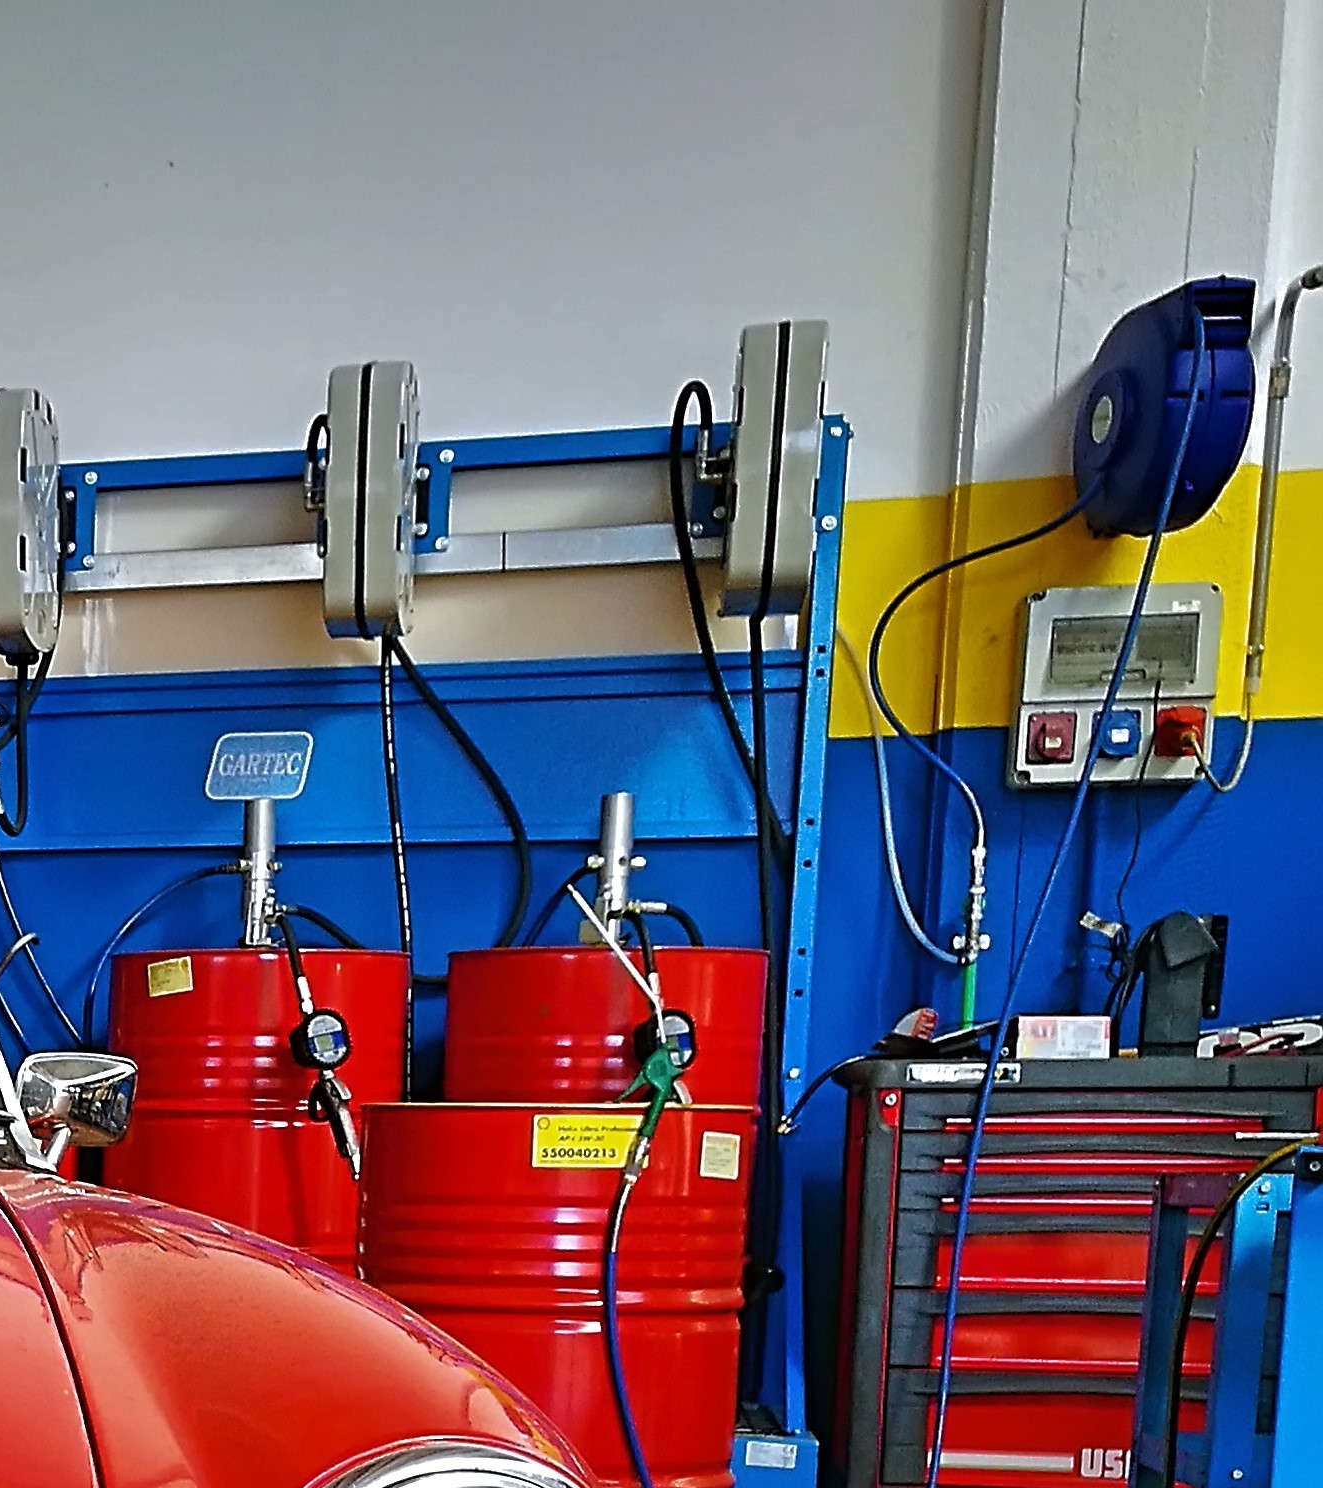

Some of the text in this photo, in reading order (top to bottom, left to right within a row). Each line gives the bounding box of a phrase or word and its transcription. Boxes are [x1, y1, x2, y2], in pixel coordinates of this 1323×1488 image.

[219, 752, 302, 777] GARTEC
[541, 1147, 617, 1159] 550040213
[1080, 1447, 1132, 1479] US
